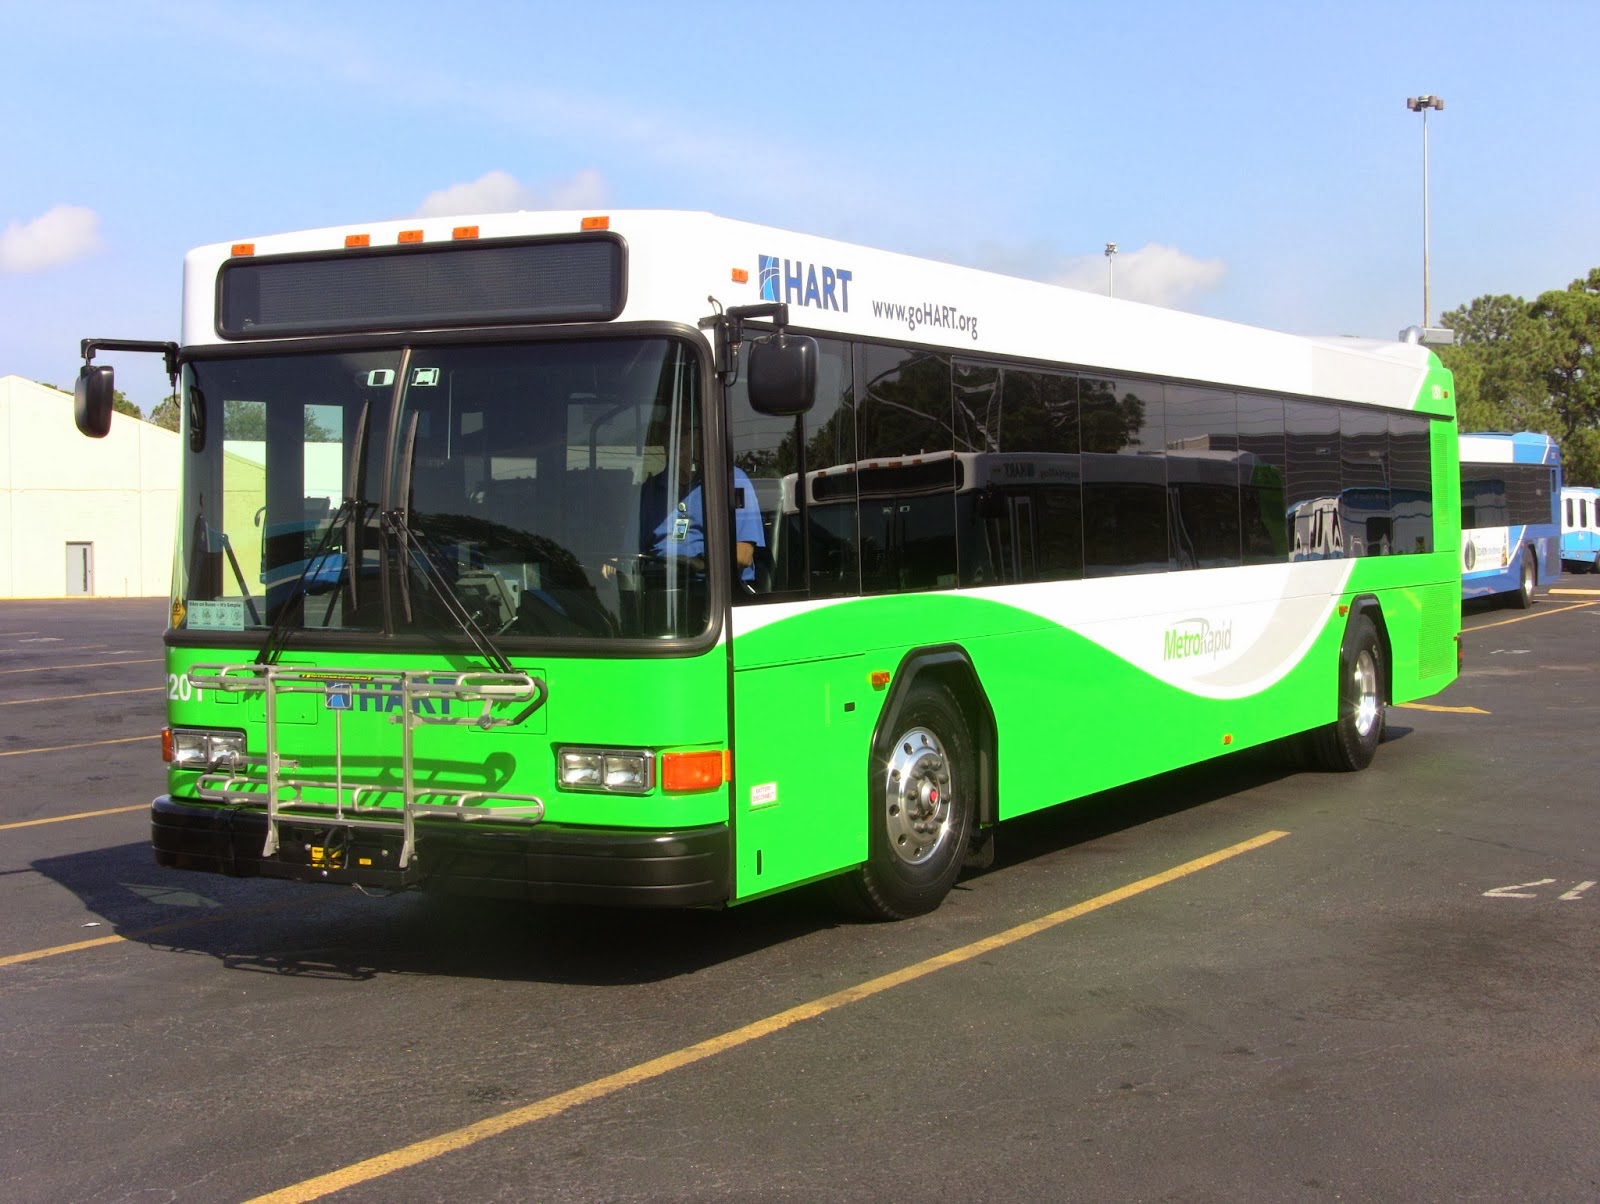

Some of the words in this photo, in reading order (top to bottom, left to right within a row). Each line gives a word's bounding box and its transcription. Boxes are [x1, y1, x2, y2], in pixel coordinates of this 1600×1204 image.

[784, 258, 853, 313] HART
[872, 300, 978, 341] www.goHART.org
[1163, 618, 1232, 661] MetroRapid
